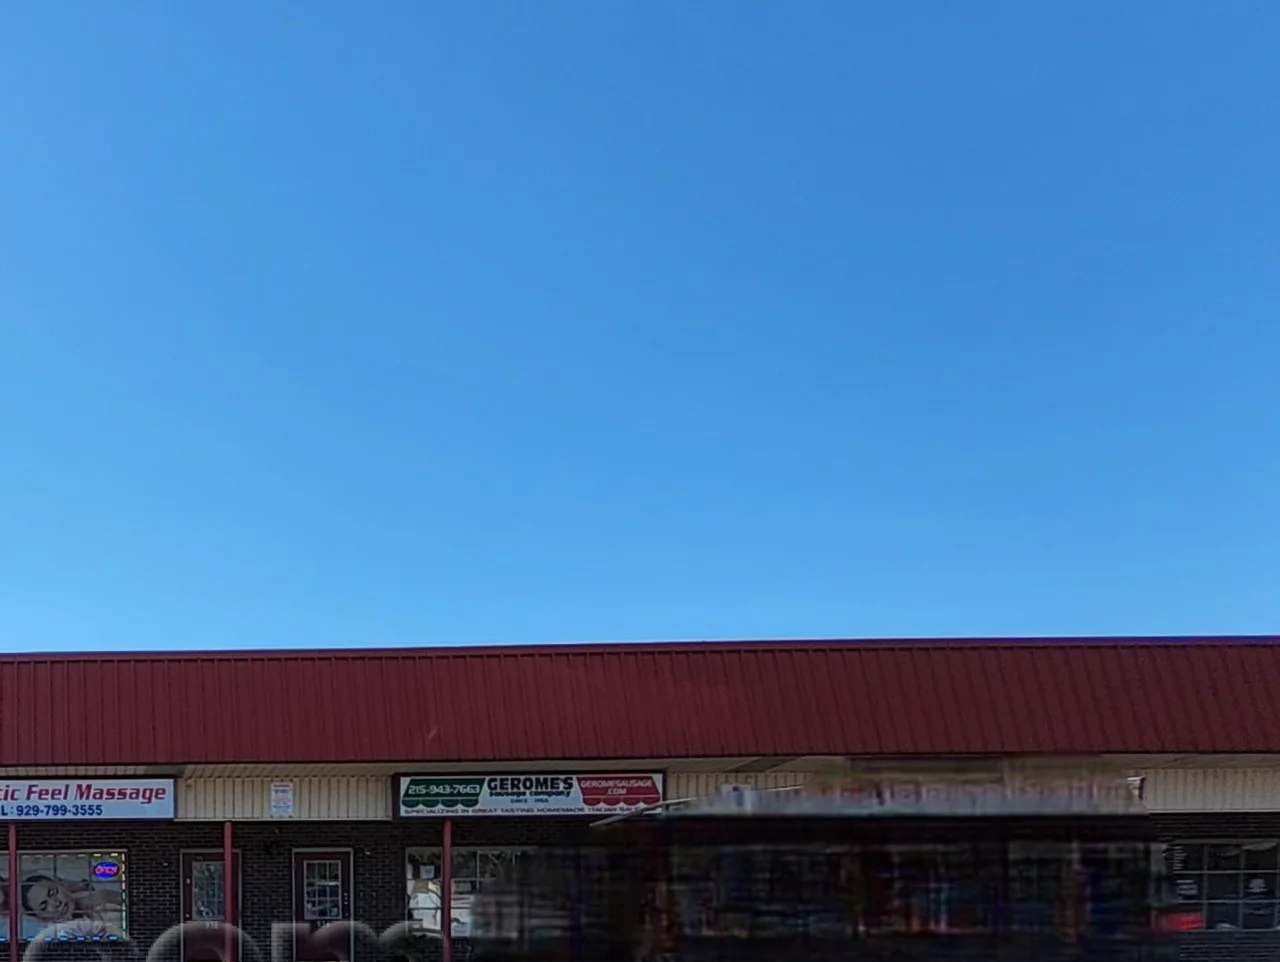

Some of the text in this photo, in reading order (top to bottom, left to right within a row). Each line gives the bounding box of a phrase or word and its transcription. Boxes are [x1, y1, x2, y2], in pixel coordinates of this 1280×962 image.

[408, 784, 481, 795] 215-943-7663
[487, 777, 574, 791] GEROME'S
[25, 783, 70, 801] Feel
[75, 783, 167, 805] Massage
[529, 790, 572, 798] company
[16, 804, 104, 817] 929-799-3555
